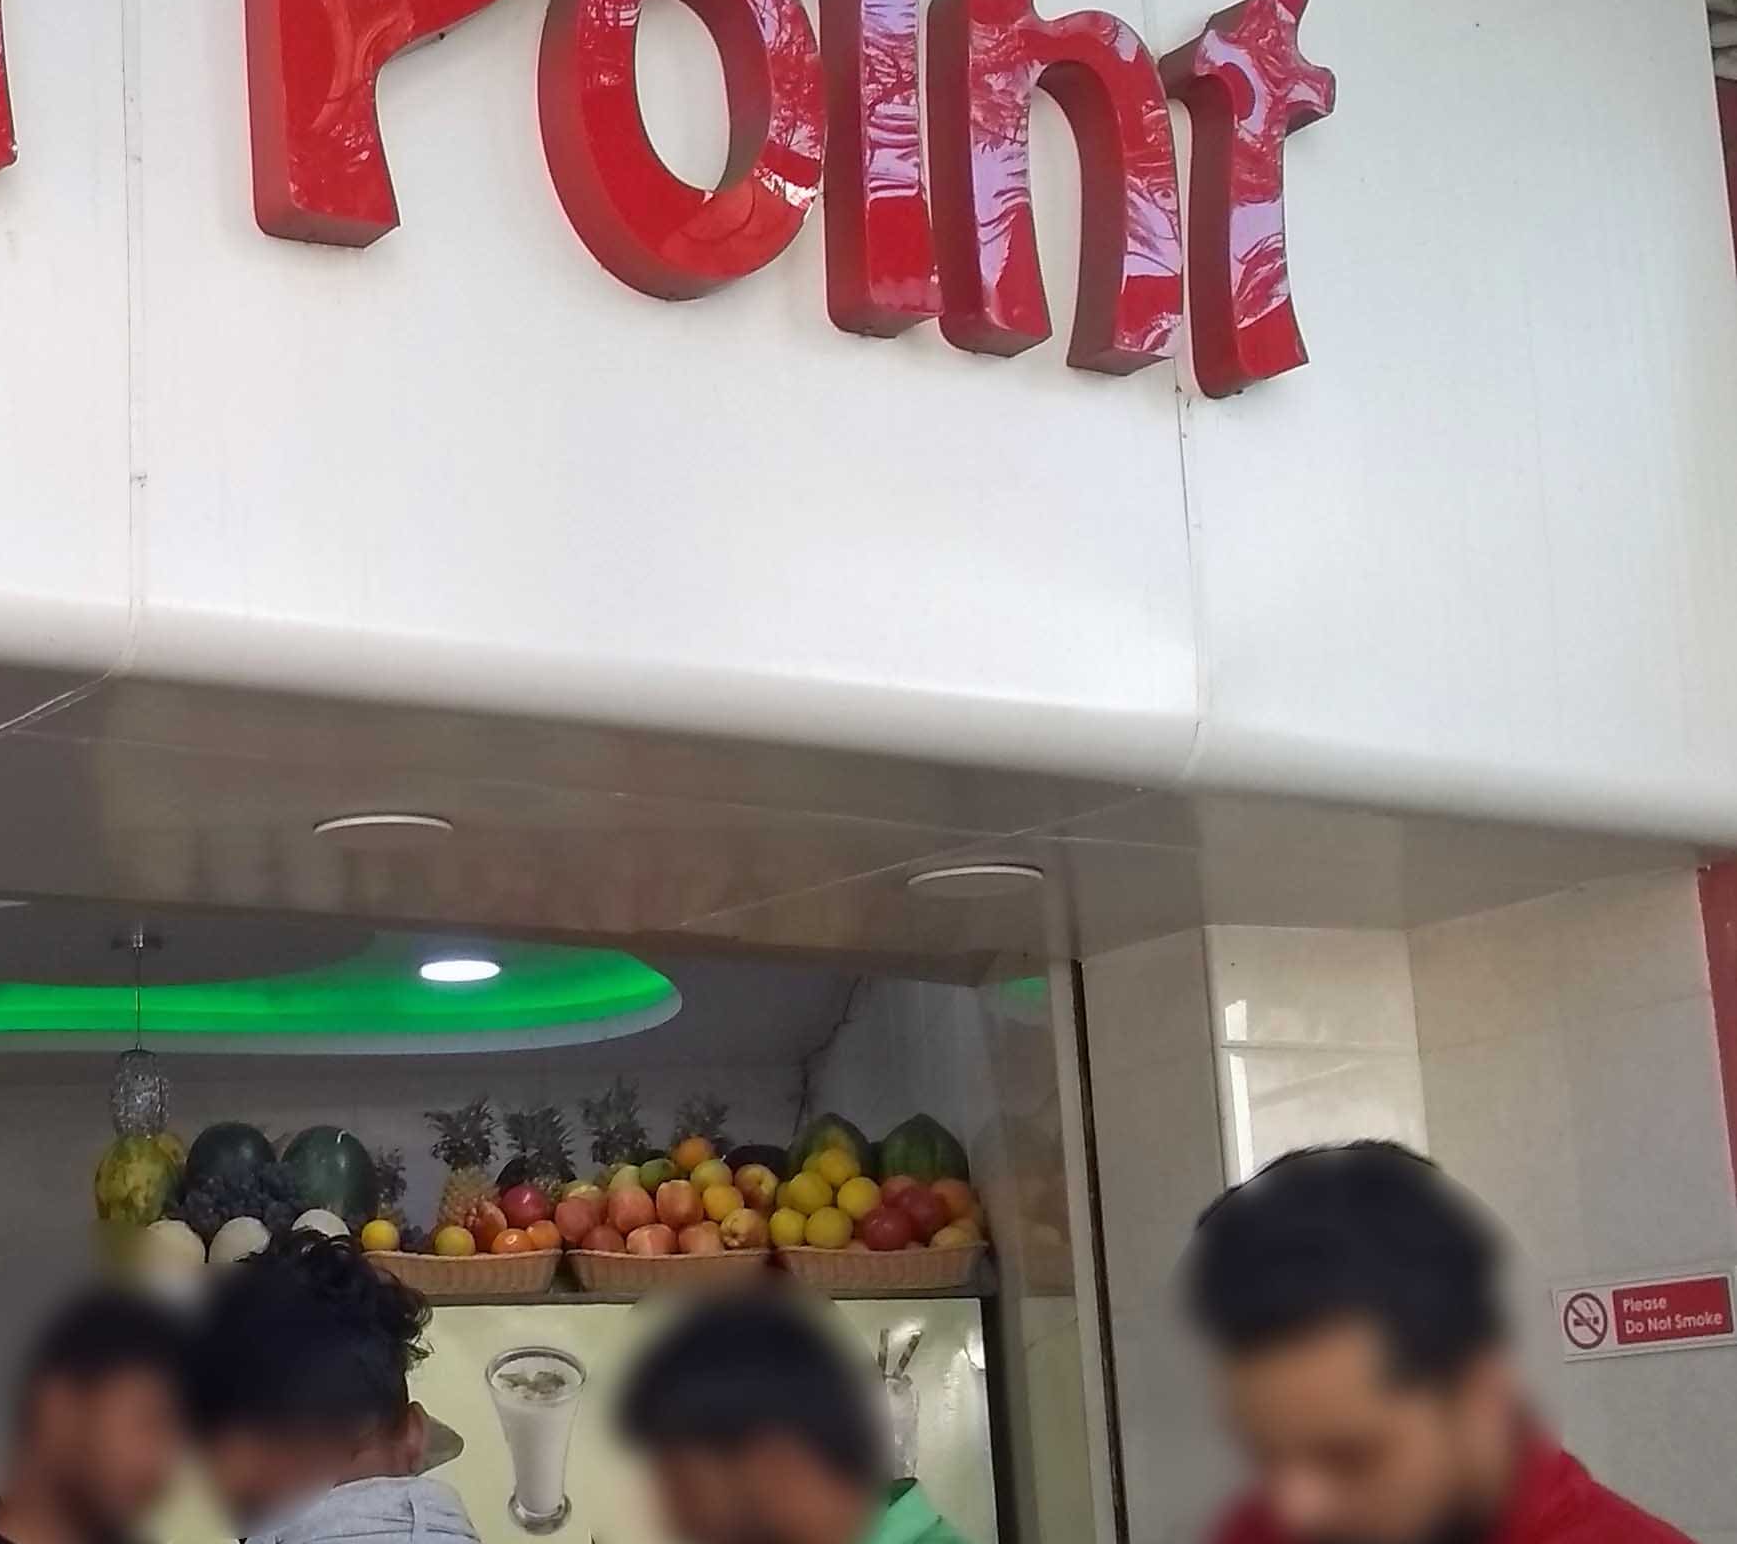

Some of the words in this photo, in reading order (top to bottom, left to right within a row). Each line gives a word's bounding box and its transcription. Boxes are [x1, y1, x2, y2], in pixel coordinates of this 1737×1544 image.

[1623, 1297, 1667, 1313] Please
[1625, 1320, 1644, 1334] Do
[1648, 1318, 1672, 1332] Not
[1674, 1311, 1723, 1330] Smoke
